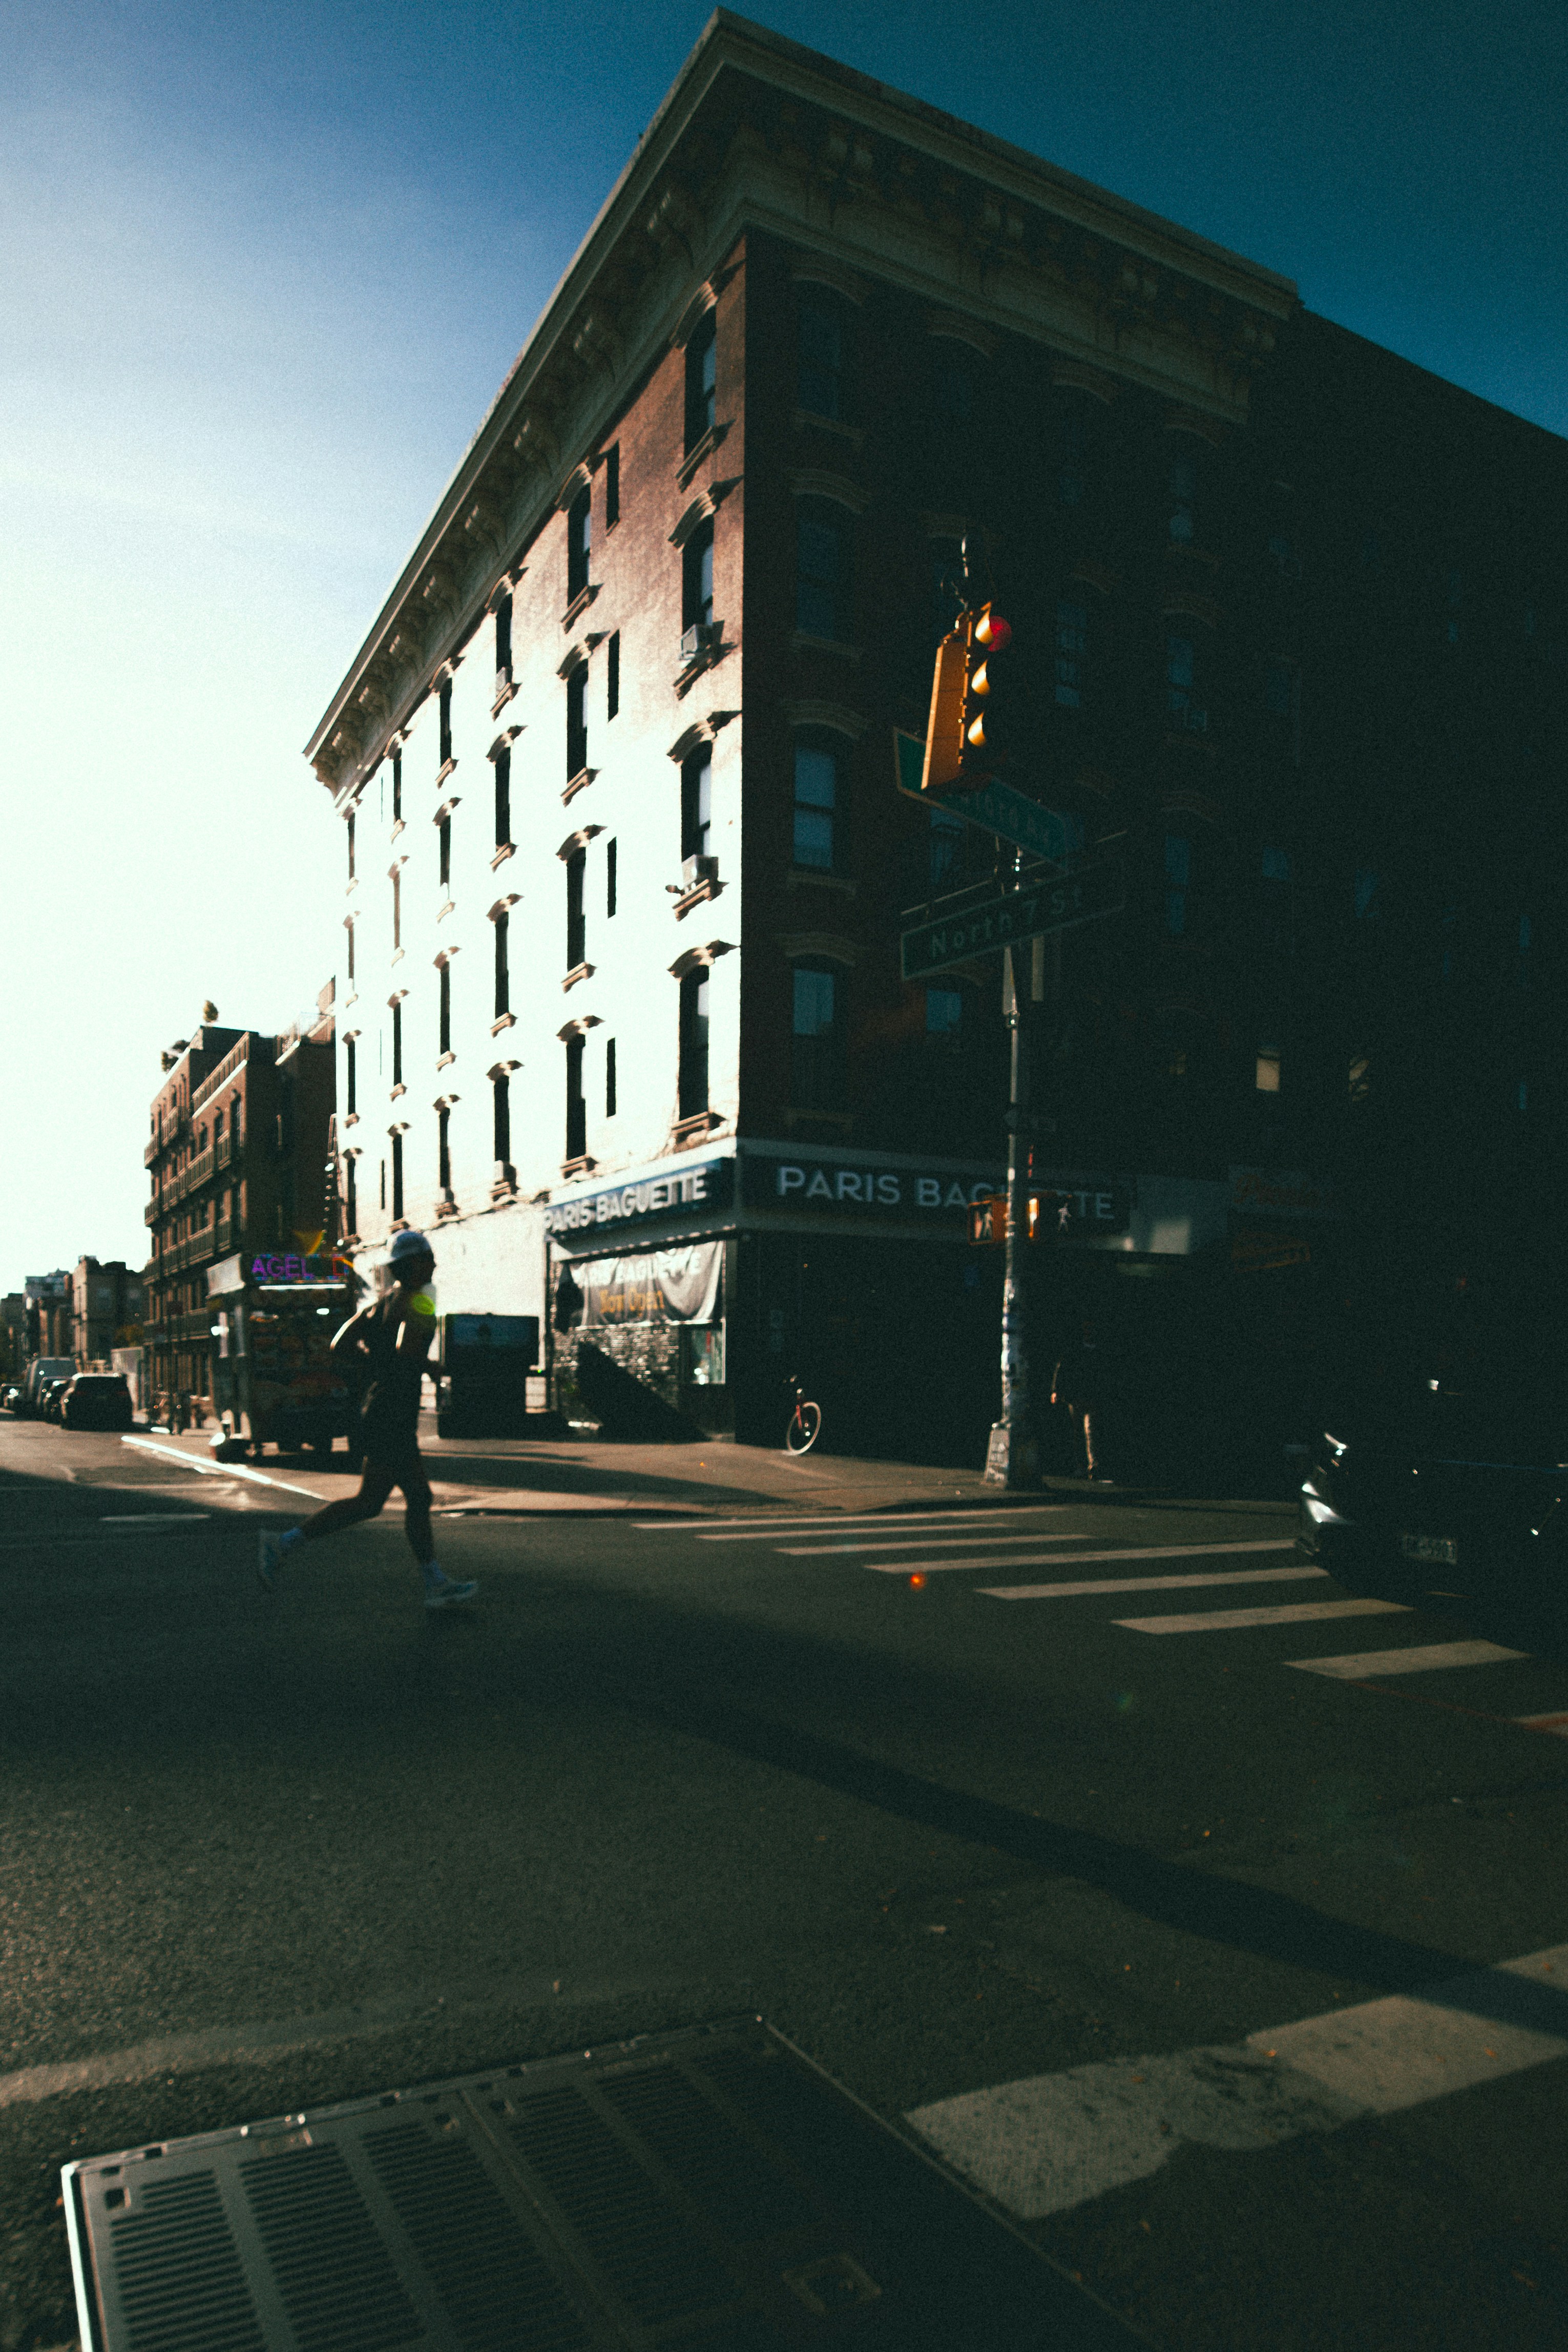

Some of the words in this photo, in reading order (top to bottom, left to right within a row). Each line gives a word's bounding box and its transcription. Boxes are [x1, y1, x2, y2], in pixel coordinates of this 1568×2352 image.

[930, 910, 1013, 958] North
[1021, 899, 1039, 925] 7
[543, 1198, 592, 1234] PARIS
[595, 1167, 708, 1223] BAGUETTE
[778, 1166, 901, 1204] PARIS
